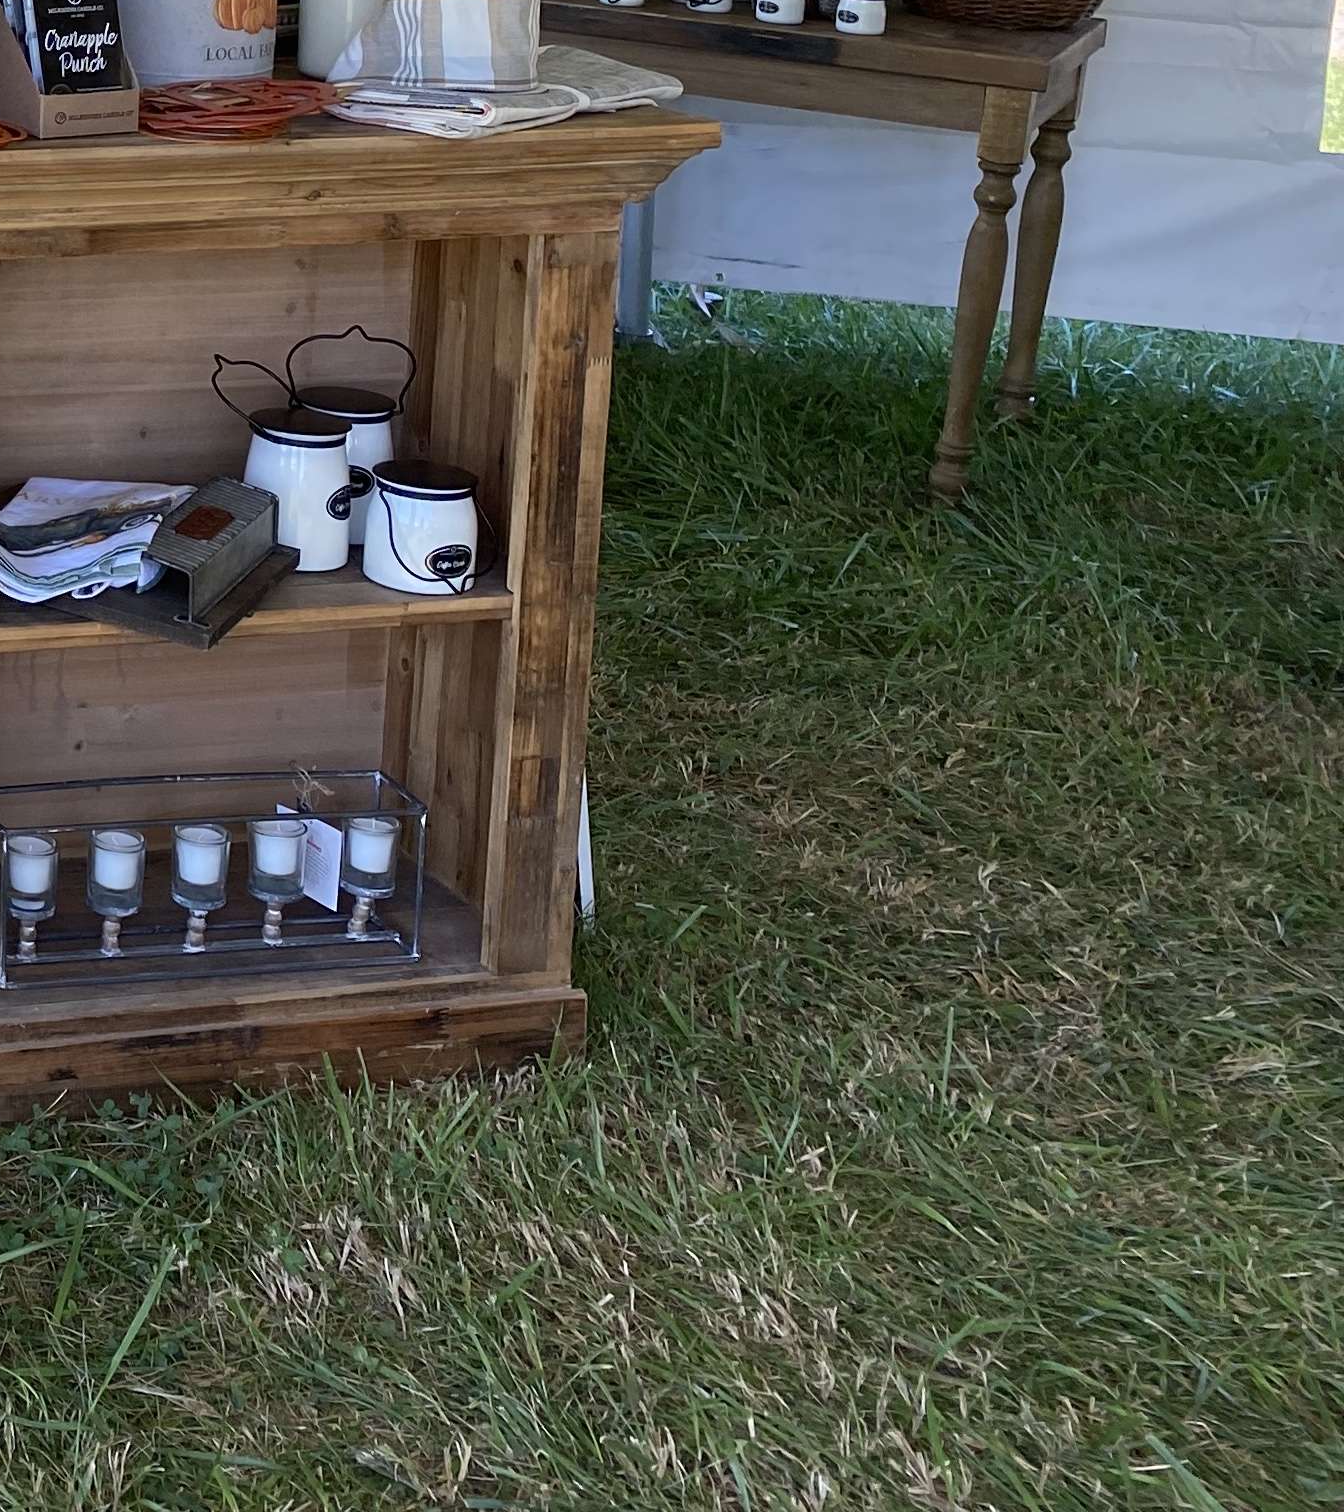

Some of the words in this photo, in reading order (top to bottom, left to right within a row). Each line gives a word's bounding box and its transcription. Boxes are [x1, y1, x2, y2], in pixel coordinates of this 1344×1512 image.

[44, 23, 119, 55] Cranapple
[58, 49, 107, 78] Punch
[205, 46, 255, 62] LOCAL
